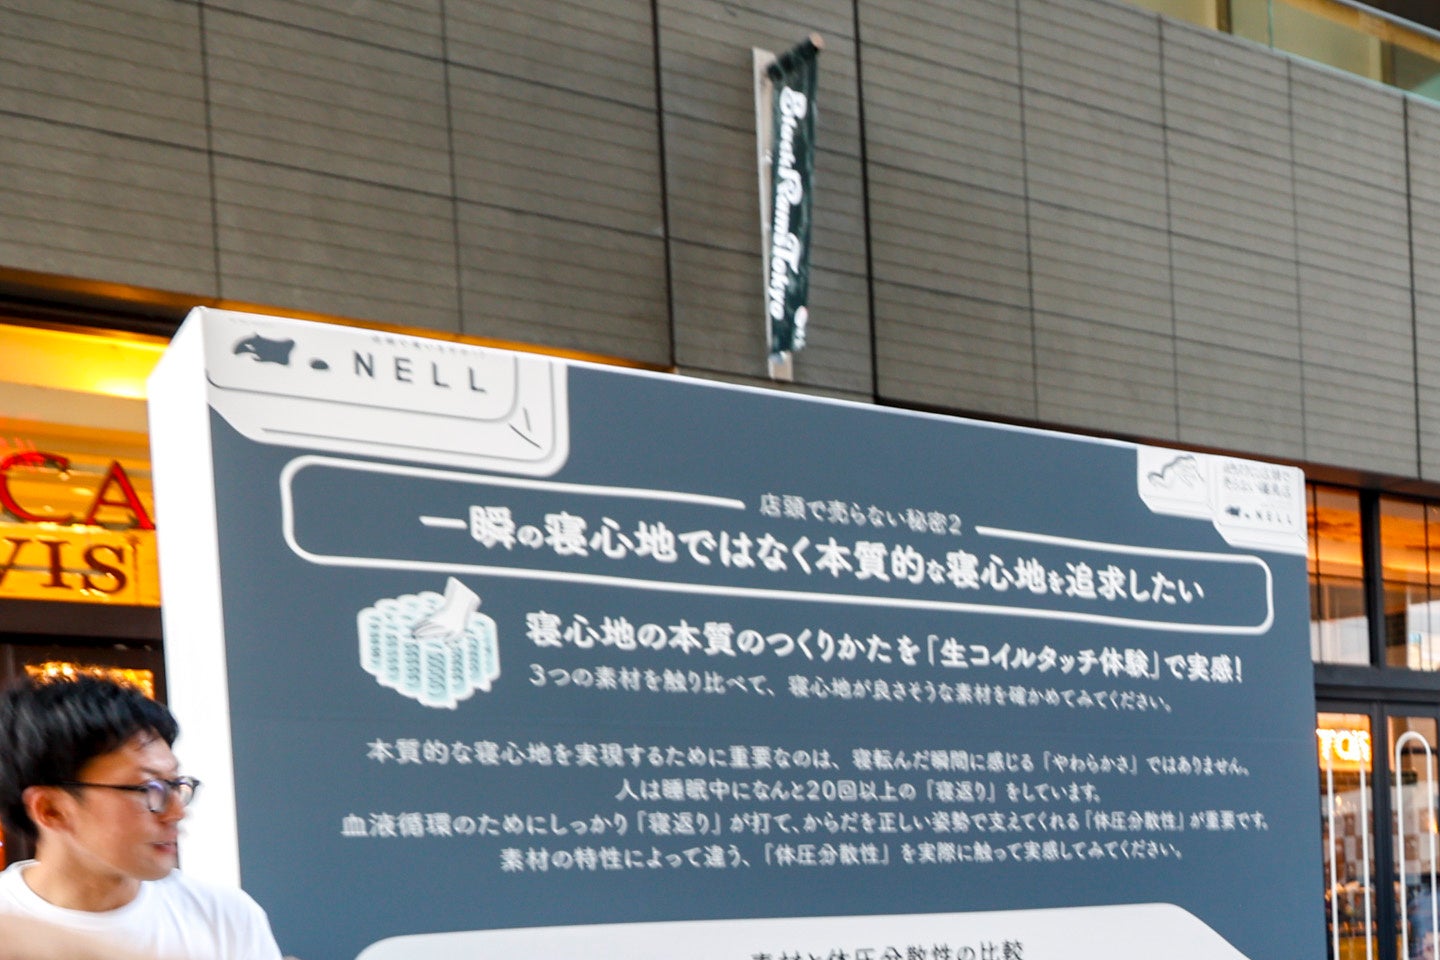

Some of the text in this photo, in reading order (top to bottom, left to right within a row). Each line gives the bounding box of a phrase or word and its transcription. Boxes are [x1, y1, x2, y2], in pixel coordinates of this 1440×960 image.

[352, 349, 488, 394] NELL
[759, 492, 964, 536] 店頭で売らない秘密2
[418, 504, 1206, 605] 一瞬の寝心地ではなく本質的な寝心地を追求したい
[525, 609, 1244, 684] 寝心地の本質のつくりかたを「生コイルタッチ体験」で実感！
